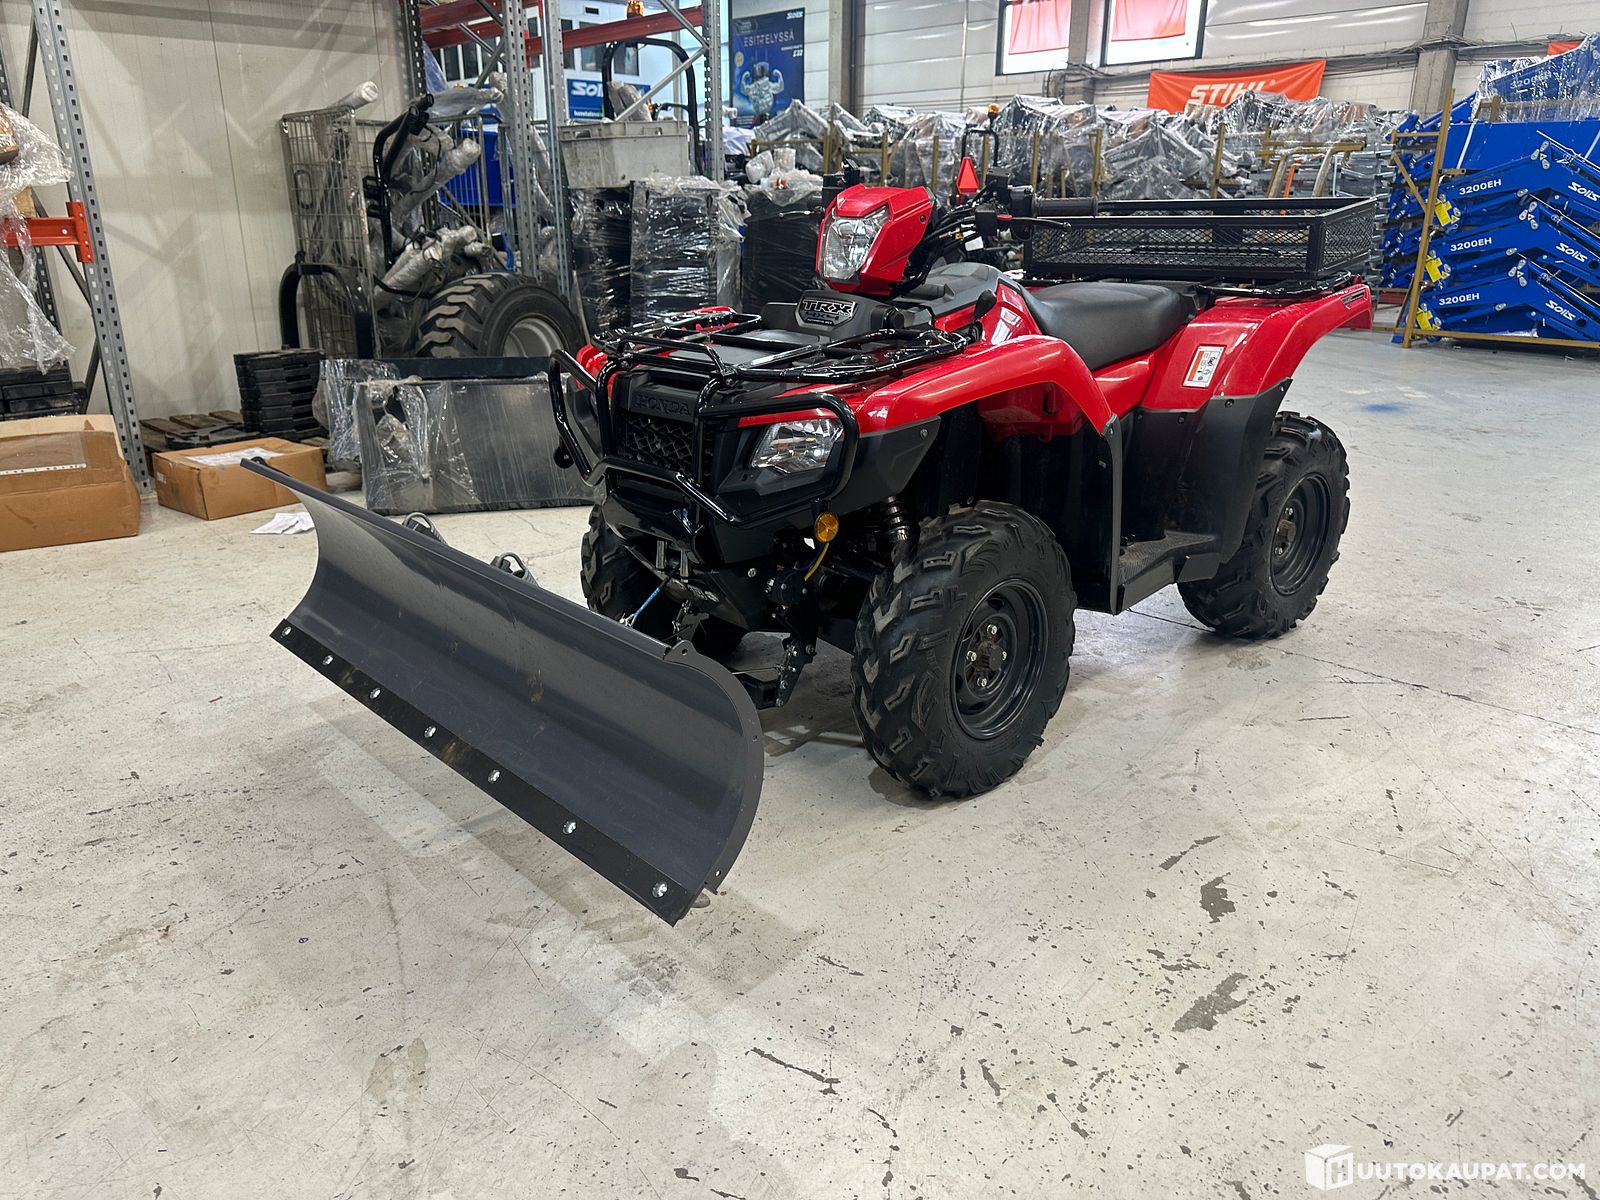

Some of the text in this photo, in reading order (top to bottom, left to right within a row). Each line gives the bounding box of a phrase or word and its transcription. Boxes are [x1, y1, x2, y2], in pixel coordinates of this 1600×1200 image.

[1459, 178, 1502, 195] 3200EH
[1450, 236, 1493, 252] 3200EH
[803, 299, 854, 315] TRX
[1438, 292, 1480, 306] 3200EH
[634, 394, 691, 416] HONDA
